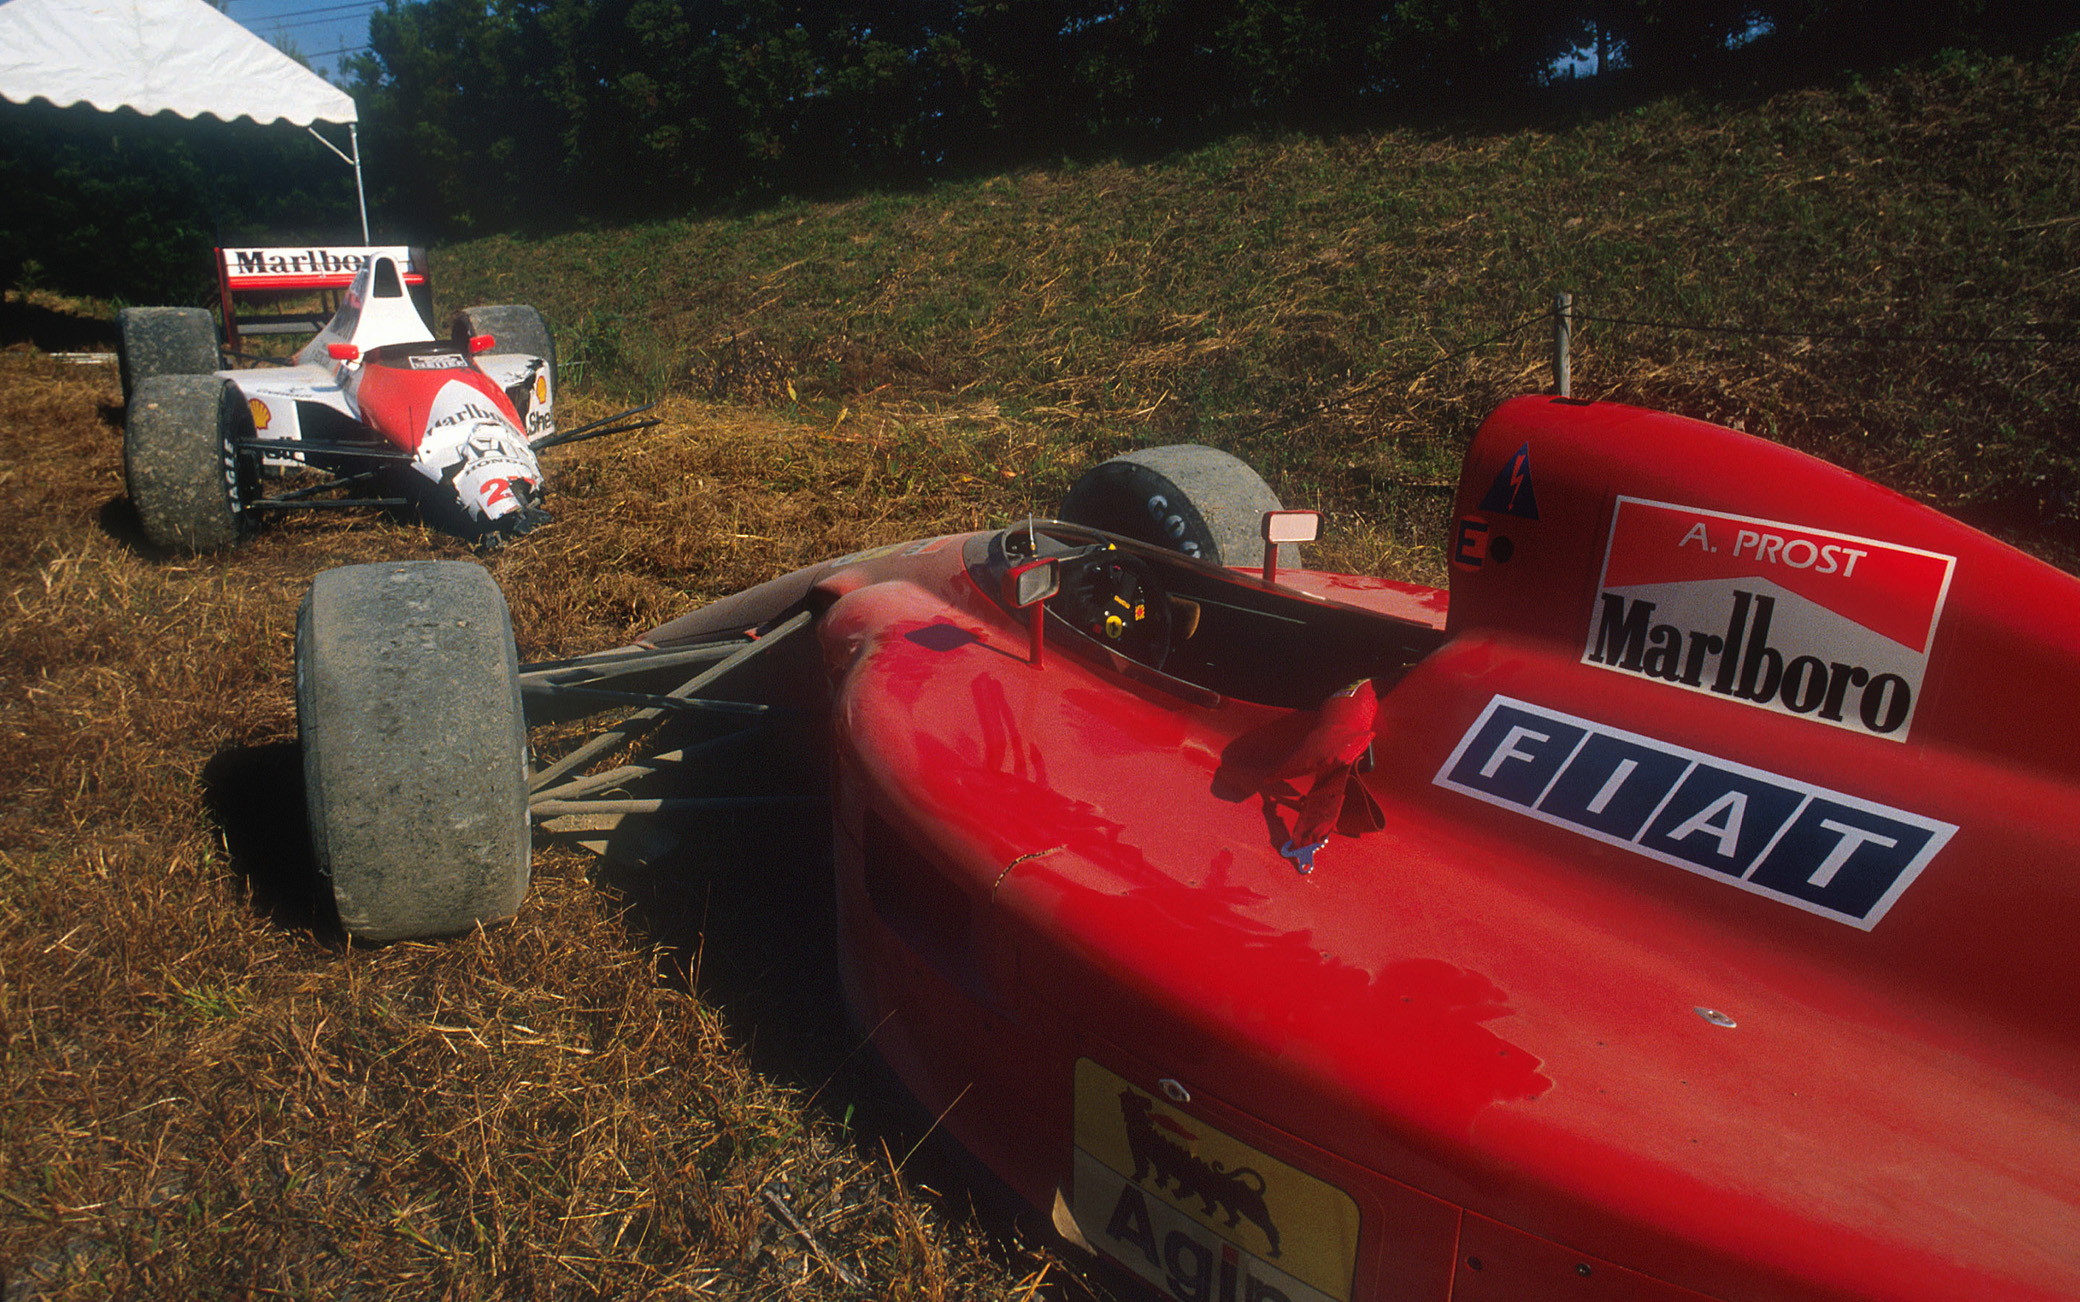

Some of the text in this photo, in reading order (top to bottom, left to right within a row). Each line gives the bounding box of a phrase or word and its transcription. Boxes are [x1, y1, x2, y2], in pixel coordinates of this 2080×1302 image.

[480, 476, 536, 507] 2
[1457, 520, 1488, 563] E
[1679, 522, 1868, 578] A. PROST
[1588, 590, 1912, 735] Marlboro
[1479, 725, 1899, 888] FIAT
